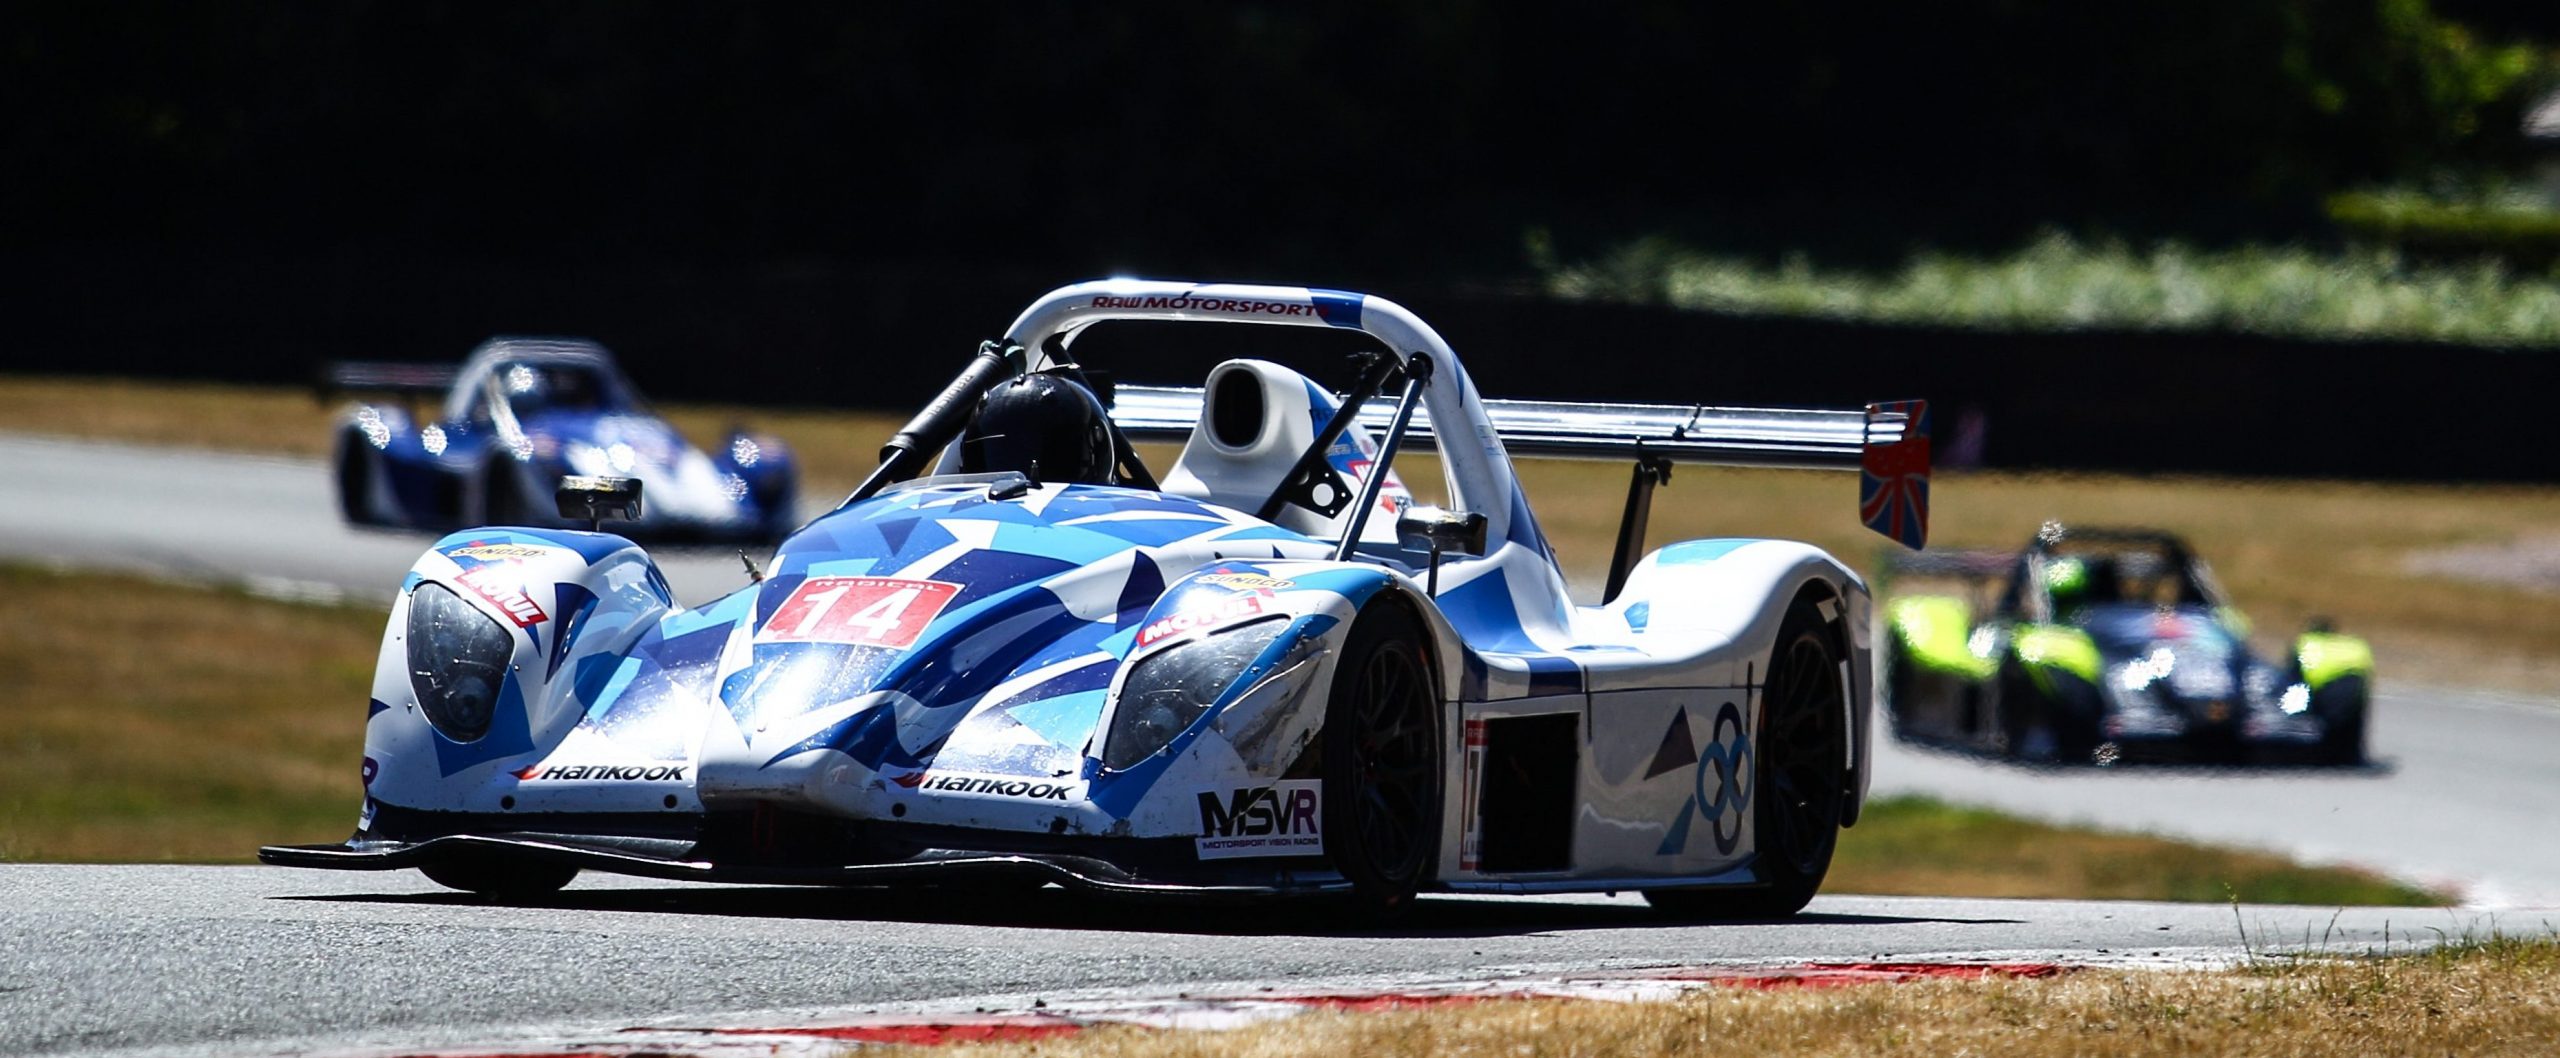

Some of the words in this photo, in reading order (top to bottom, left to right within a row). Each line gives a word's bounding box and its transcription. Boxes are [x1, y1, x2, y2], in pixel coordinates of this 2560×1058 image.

[1091, 296, 1142, 309] RAW
[815, 580, 941, 592] RADICAL
[1202, 575, 1293, 588] SUNOCO
[791, 586, 922, 639] 14
[1143, 598, 1258, 644] MOTUL
[1197, 787, 1319, 838] MSVR
[1203, 839, 1266, 850] MOTORSPORT
[1269, 839, 1292, 847] VISION
[1294, 837, 1319, 846] RACING
